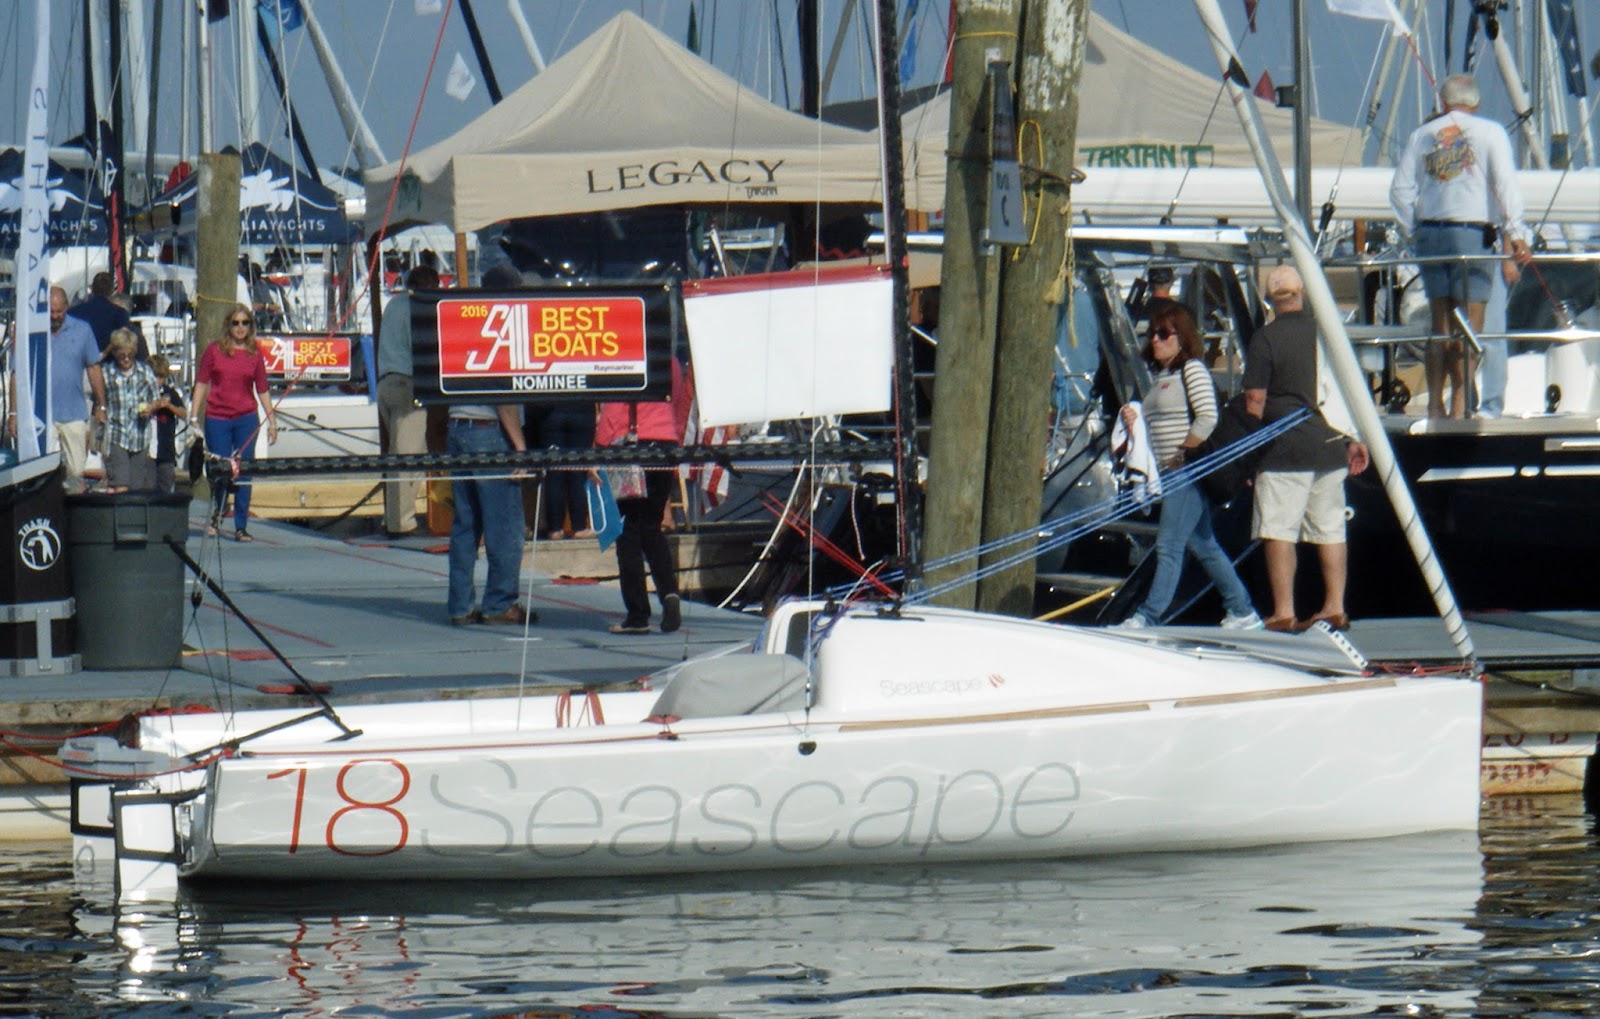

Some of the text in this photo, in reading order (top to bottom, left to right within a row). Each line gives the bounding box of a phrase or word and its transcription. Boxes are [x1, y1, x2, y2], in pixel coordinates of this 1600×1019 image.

[1079, 144, 1176, 168] TARTAN
[586, 159, 785, 193] LEGACY
[461, 306, 489, 318] 2016
[541, 306, 610, 332] BEST
[300, 341, 334, 354] BEST
[533, 331, 619, 358] BOATS
[295, 353, 338, 365] BOATS
[512, 375, 587, 390] NOMINEE
[18, 518, 51, 537] TRASH
[880, 677, 982, 698] Seascape
[266, 759, 1081, 859] 18 Seascape
